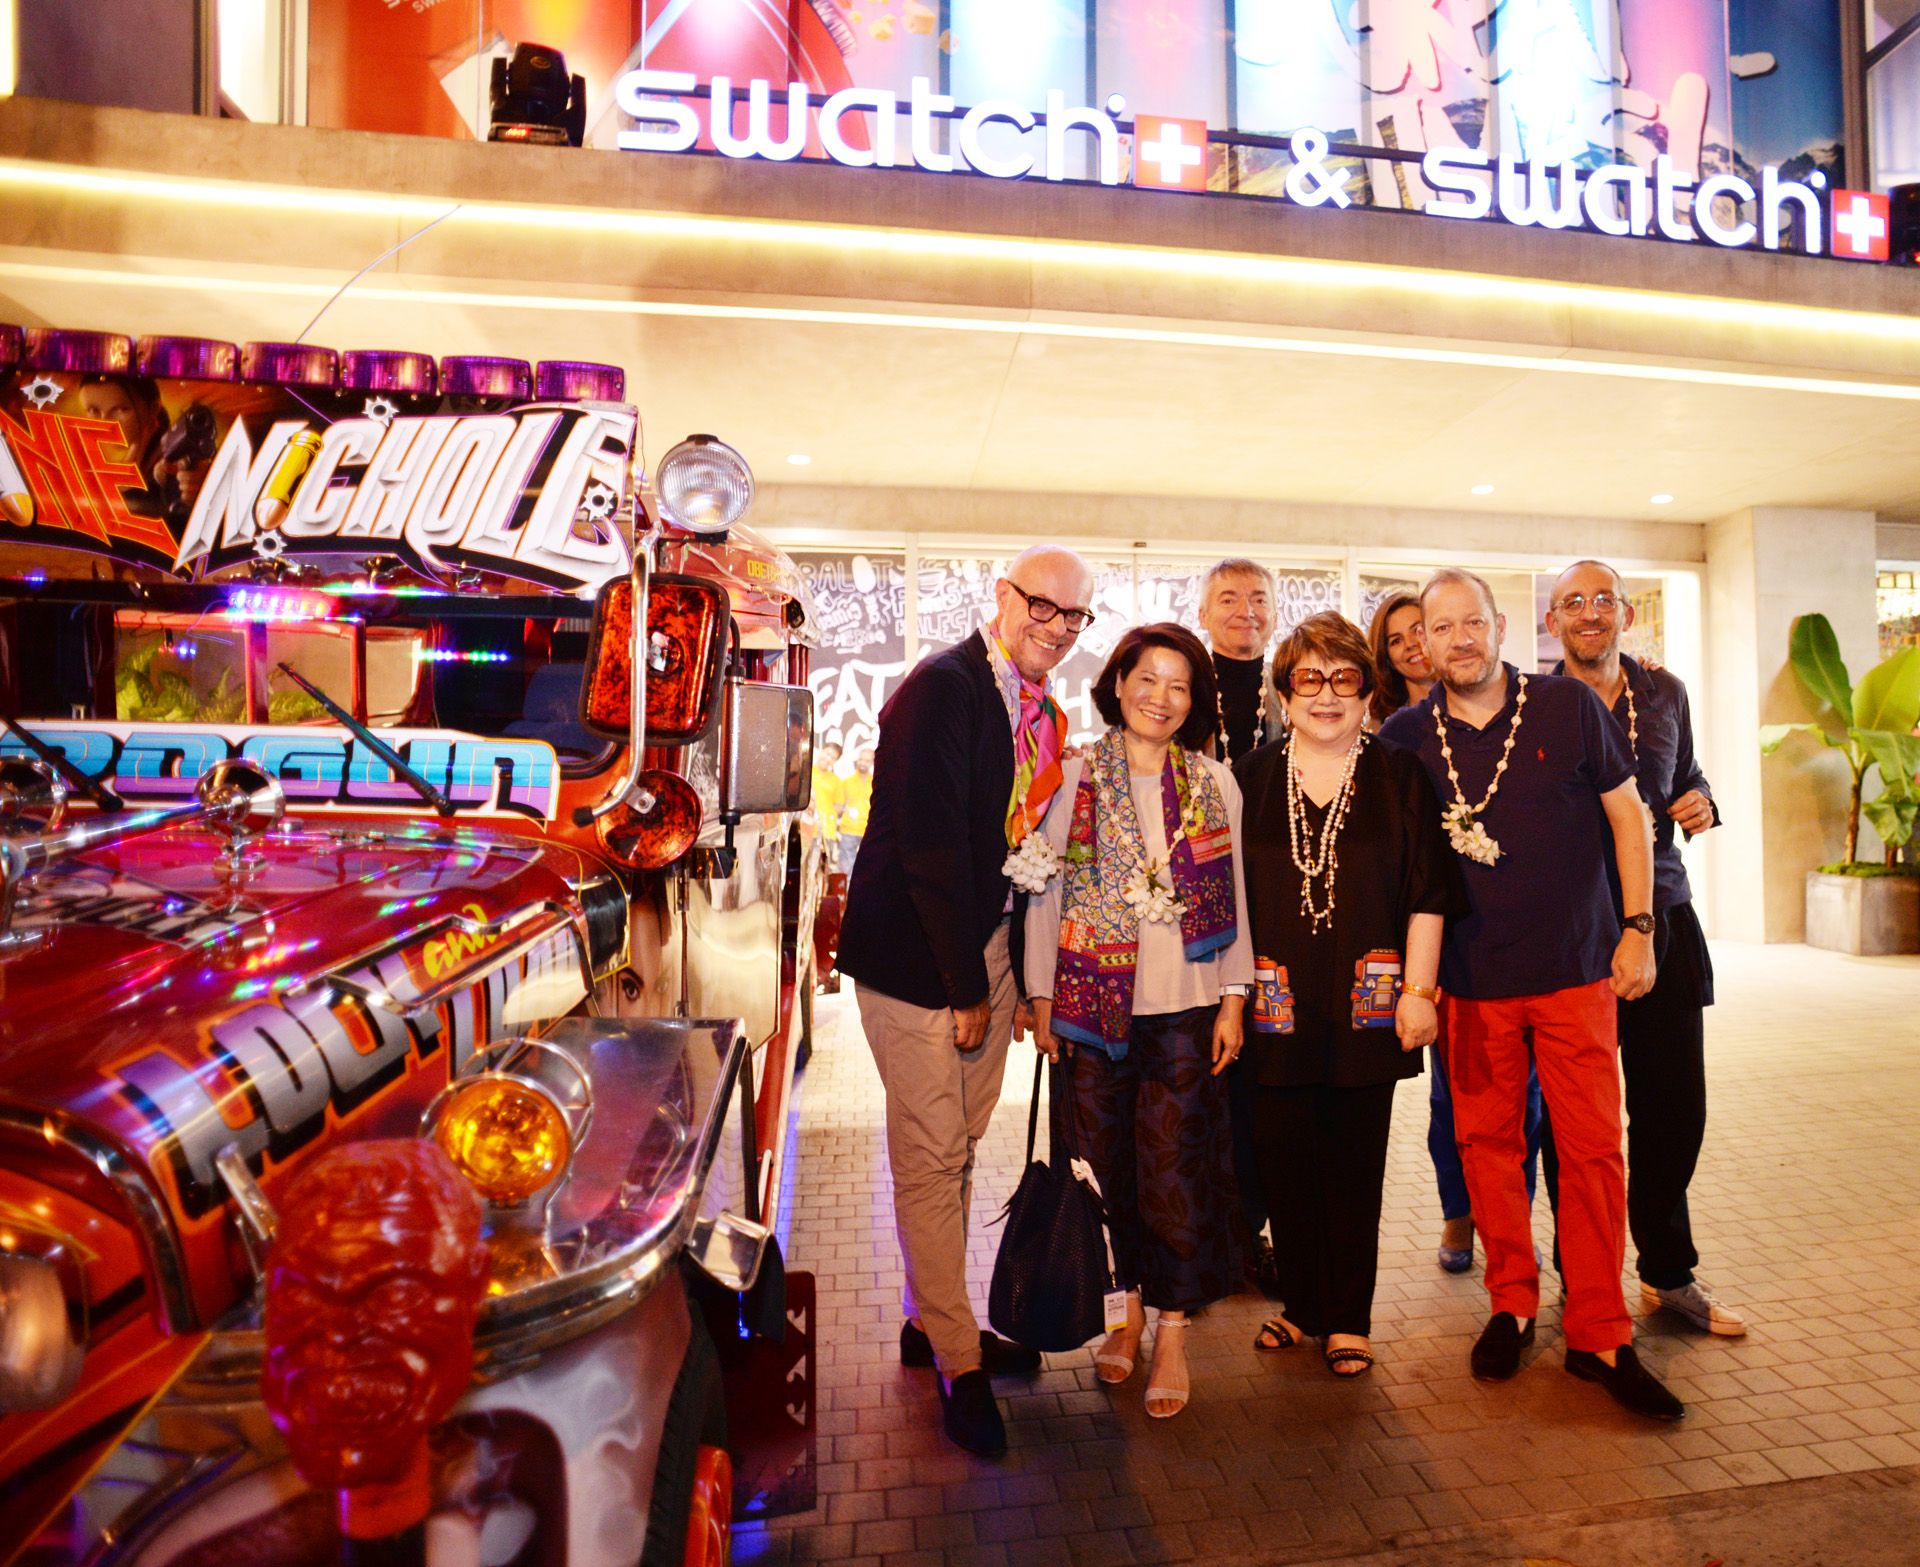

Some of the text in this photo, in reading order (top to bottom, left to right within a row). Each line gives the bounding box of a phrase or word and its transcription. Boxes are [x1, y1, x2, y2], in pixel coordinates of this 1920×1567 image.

[615, 69, 1827, 255] swatch & swatch
[174, 412, 636, 592] NICHOLE
